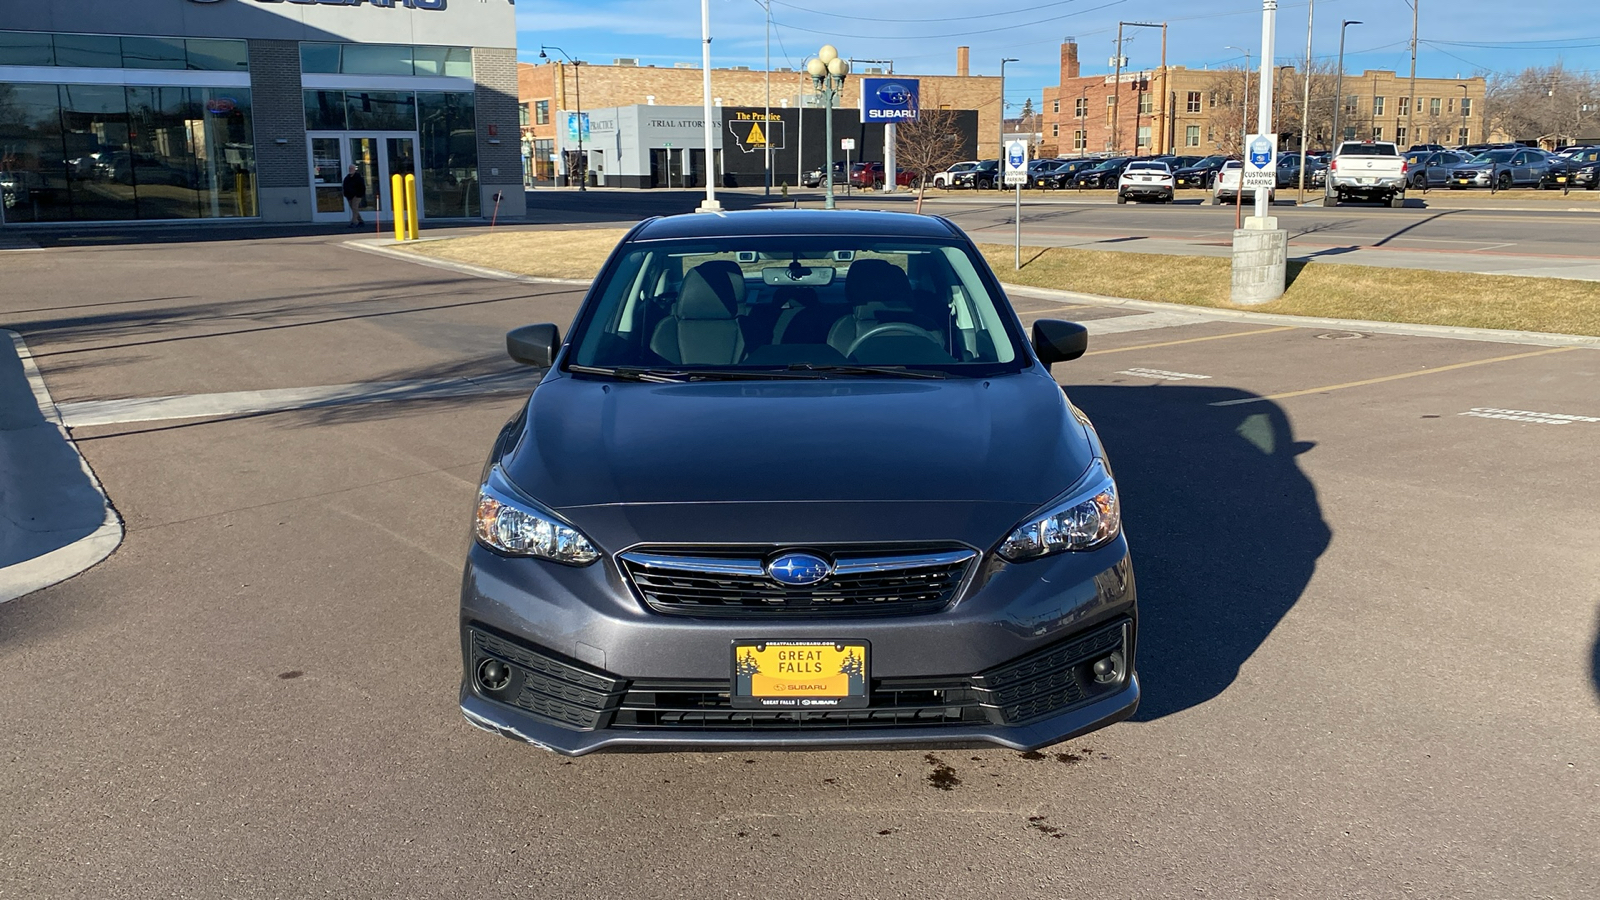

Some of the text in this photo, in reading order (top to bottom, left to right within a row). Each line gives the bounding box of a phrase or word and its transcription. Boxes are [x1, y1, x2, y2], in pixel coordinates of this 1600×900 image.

[736, 112, 781, 121] The Pratice
[869, 109, 916, 118] SUBARU
[651, 120, 722, 128] TRIAL ATTORNYS
[778, 650, 822, 661] GREAT
[778, 662, 822, 673] FALLS
